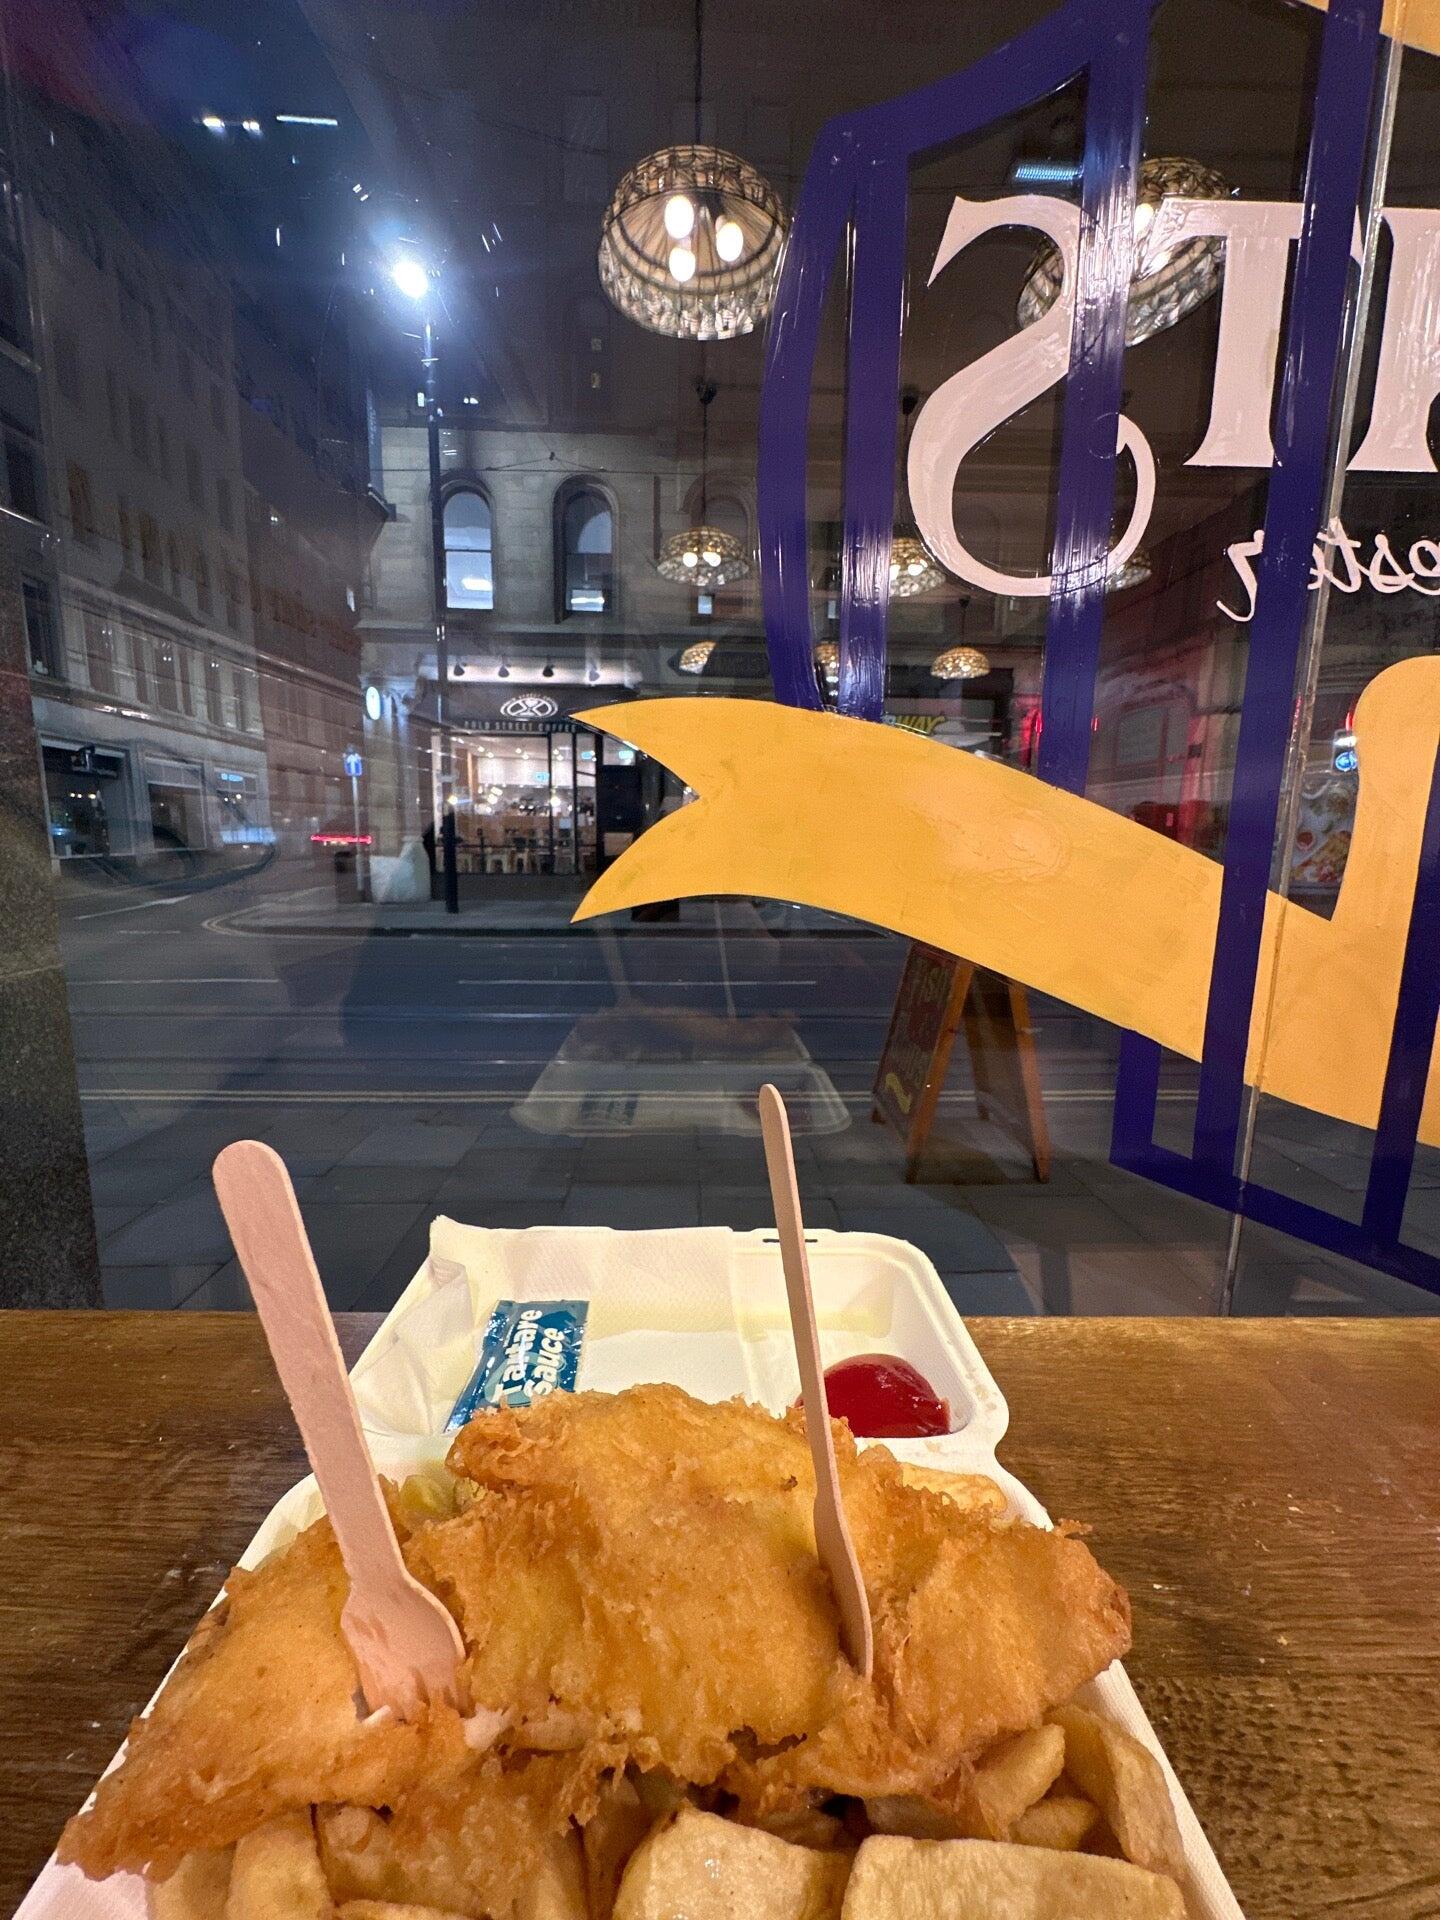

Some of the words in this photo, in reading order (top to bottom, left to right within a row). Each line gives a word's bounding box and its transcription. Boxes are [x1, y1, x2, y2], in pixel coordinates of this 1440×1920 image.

[495, 721, 533, 731] STREET
[490, 1309, 543, 1403] Tartare
[523, 1327, 565, 1398] Sauce
